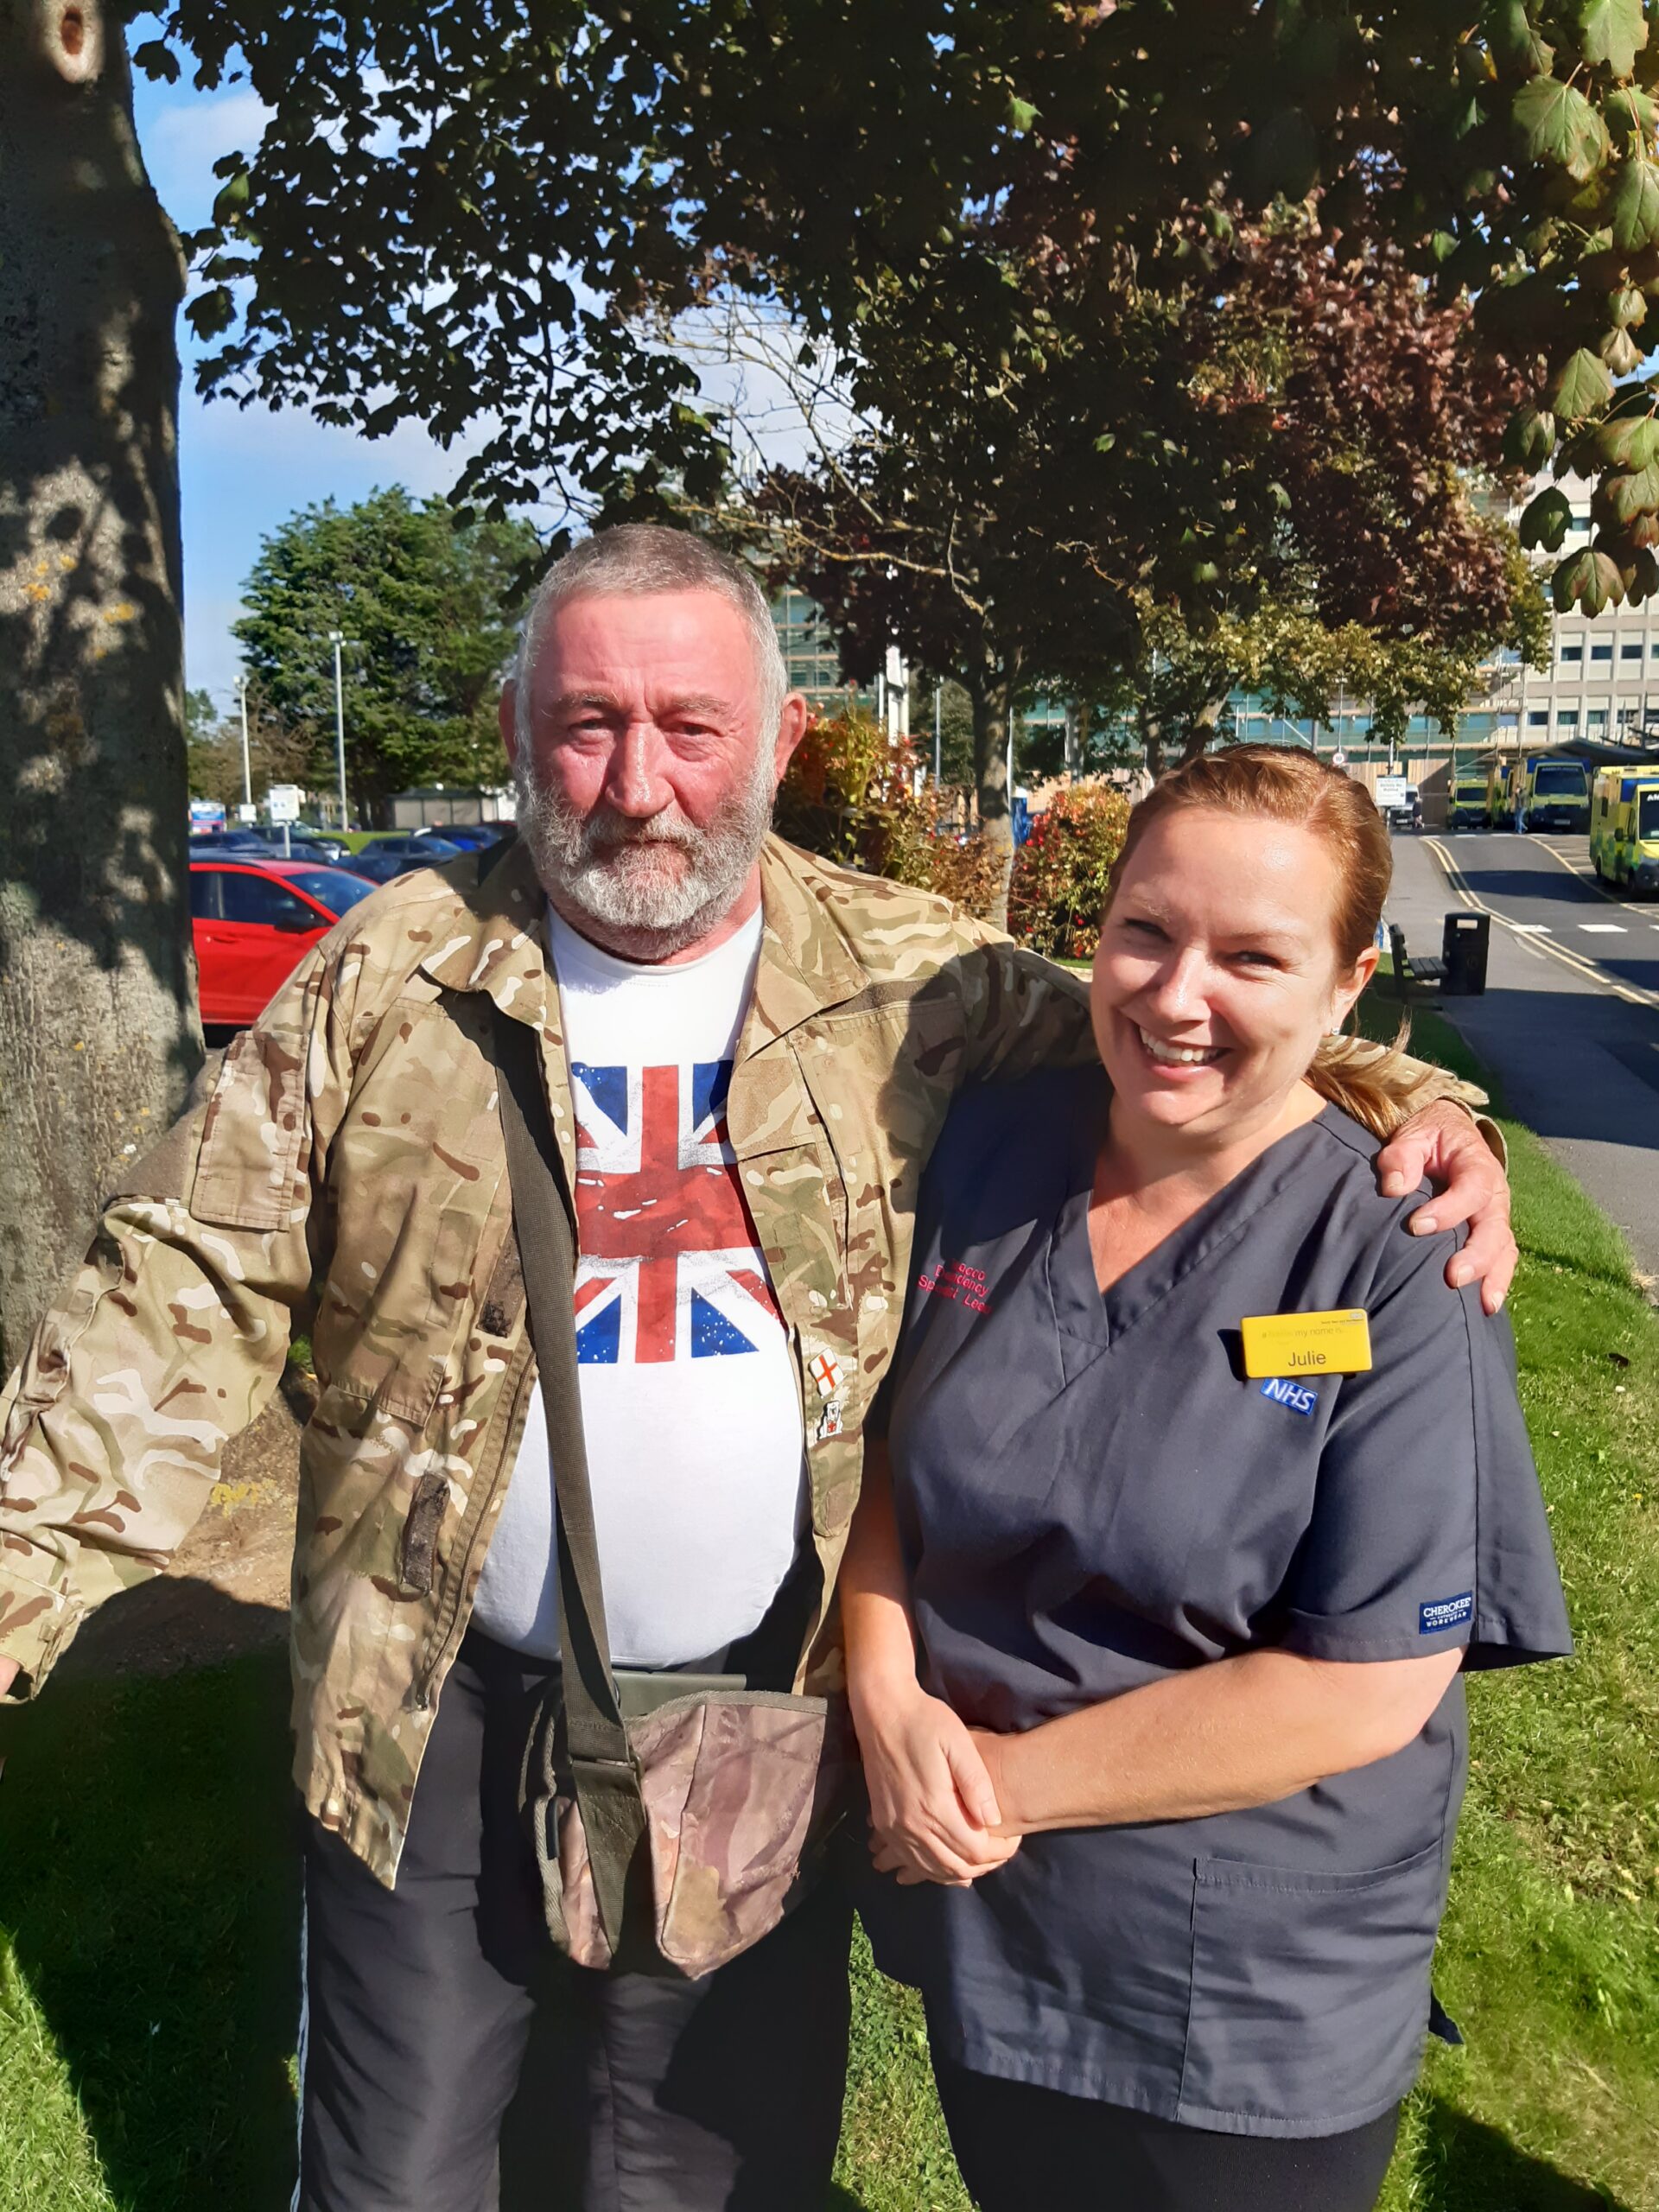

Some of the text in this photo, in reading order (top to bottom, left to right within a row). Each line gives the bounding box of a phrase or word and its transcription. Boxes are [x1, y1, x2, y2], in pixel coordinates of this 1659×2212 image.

[1310, 1326, 1334, 1335] name
[1287, 1350, 1326, 1367] Julie
[1263, 1378, 1315, 1410] NHS
[1423, 1597, 1471, 1618] CHEROKEE
[1426, 1611, 1467, 1627] WORKWEAR
